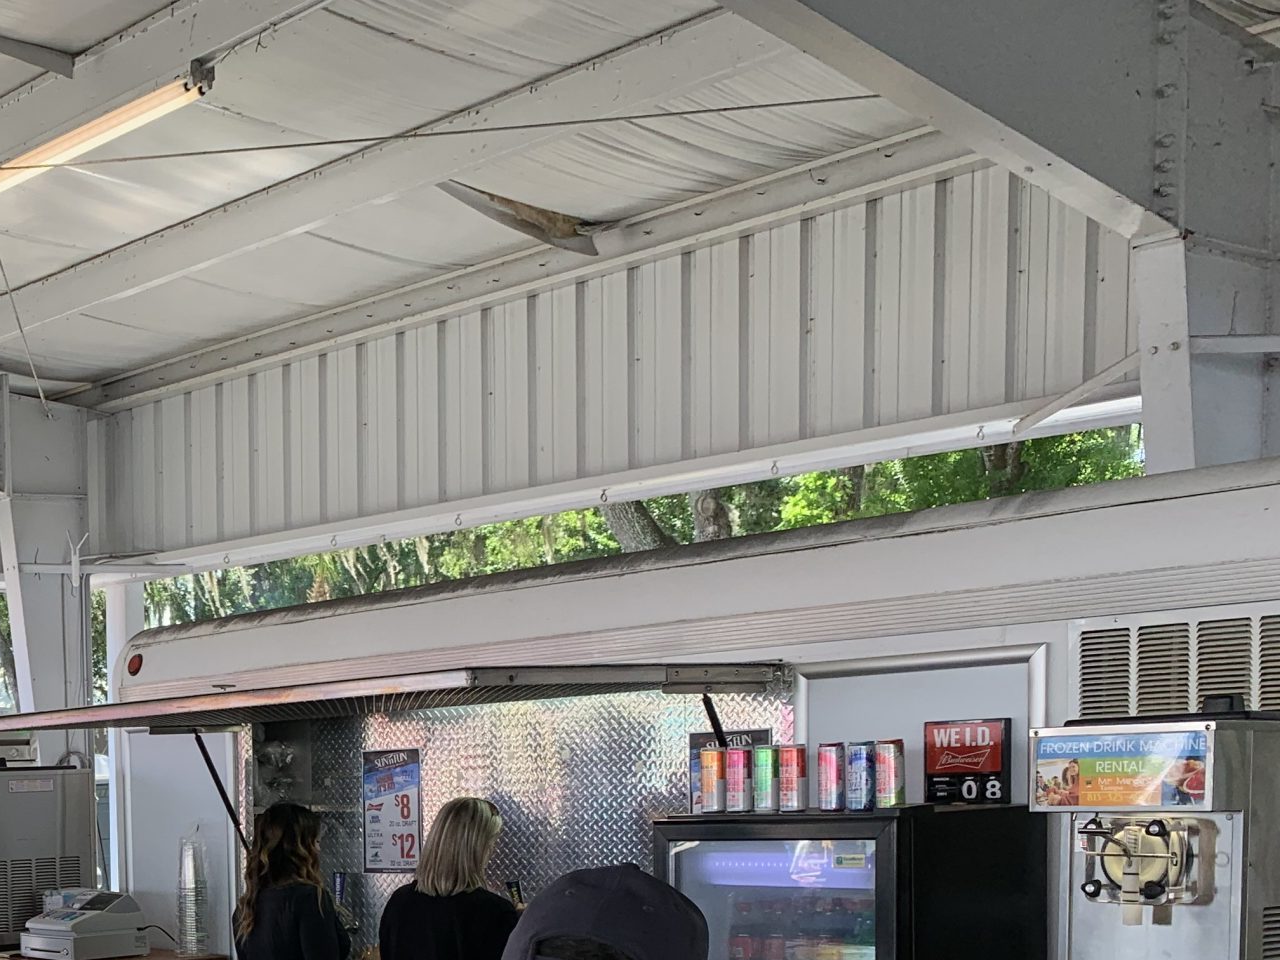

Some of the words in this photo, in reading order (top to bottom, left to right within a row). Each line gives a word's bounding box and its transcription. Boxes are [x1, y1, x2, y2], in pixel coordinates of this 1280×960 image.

[933, 728, 960, 748] WE
[965, 726, 994, 747] I.D.
[1040, 742, 1089, 754] FROZEN
[1093, 740, 1136, 752] DRINK
[1139, 737, 1207, 751] MACHINE
[941, 754, 984, 764] Budweiser
[1095, 761, 1146, 773] RENTAL
[395, 794, 411, 820] $8
[391, 833, 416, 859] $12
